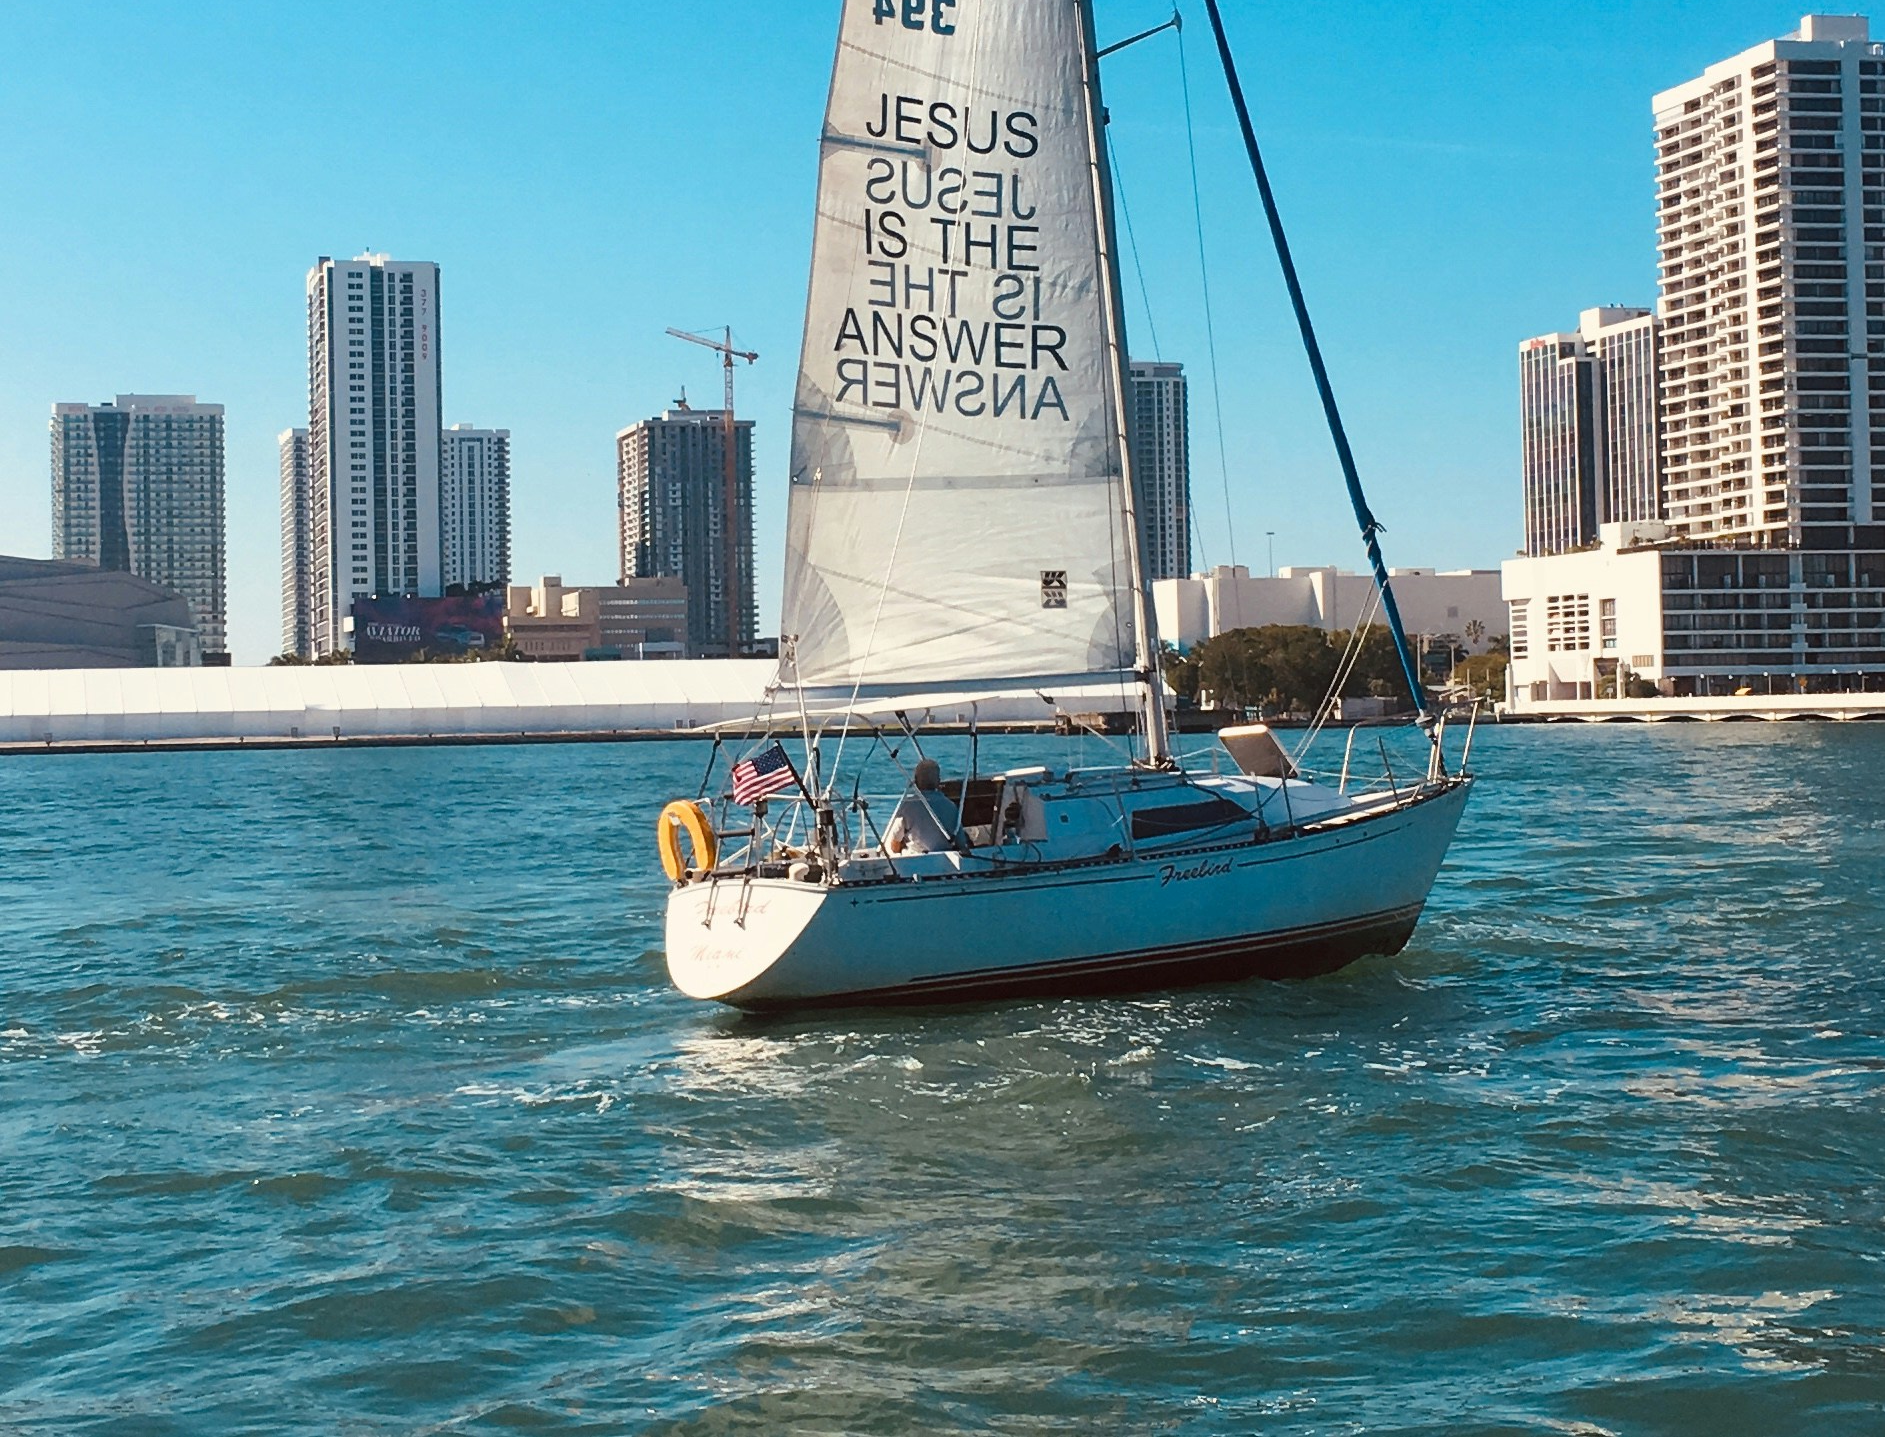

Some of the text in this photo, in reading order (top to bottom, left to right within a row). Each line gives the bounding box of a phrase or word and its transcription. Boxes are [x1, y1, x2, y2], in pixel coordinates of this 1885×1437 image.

[866, 93, 1038, 158] JESUS
[864, 208, 1040, 271] IS THE
[834, 307, 1069, 371] ANSWER
[1159, 857, 1233, 887] Freebird
